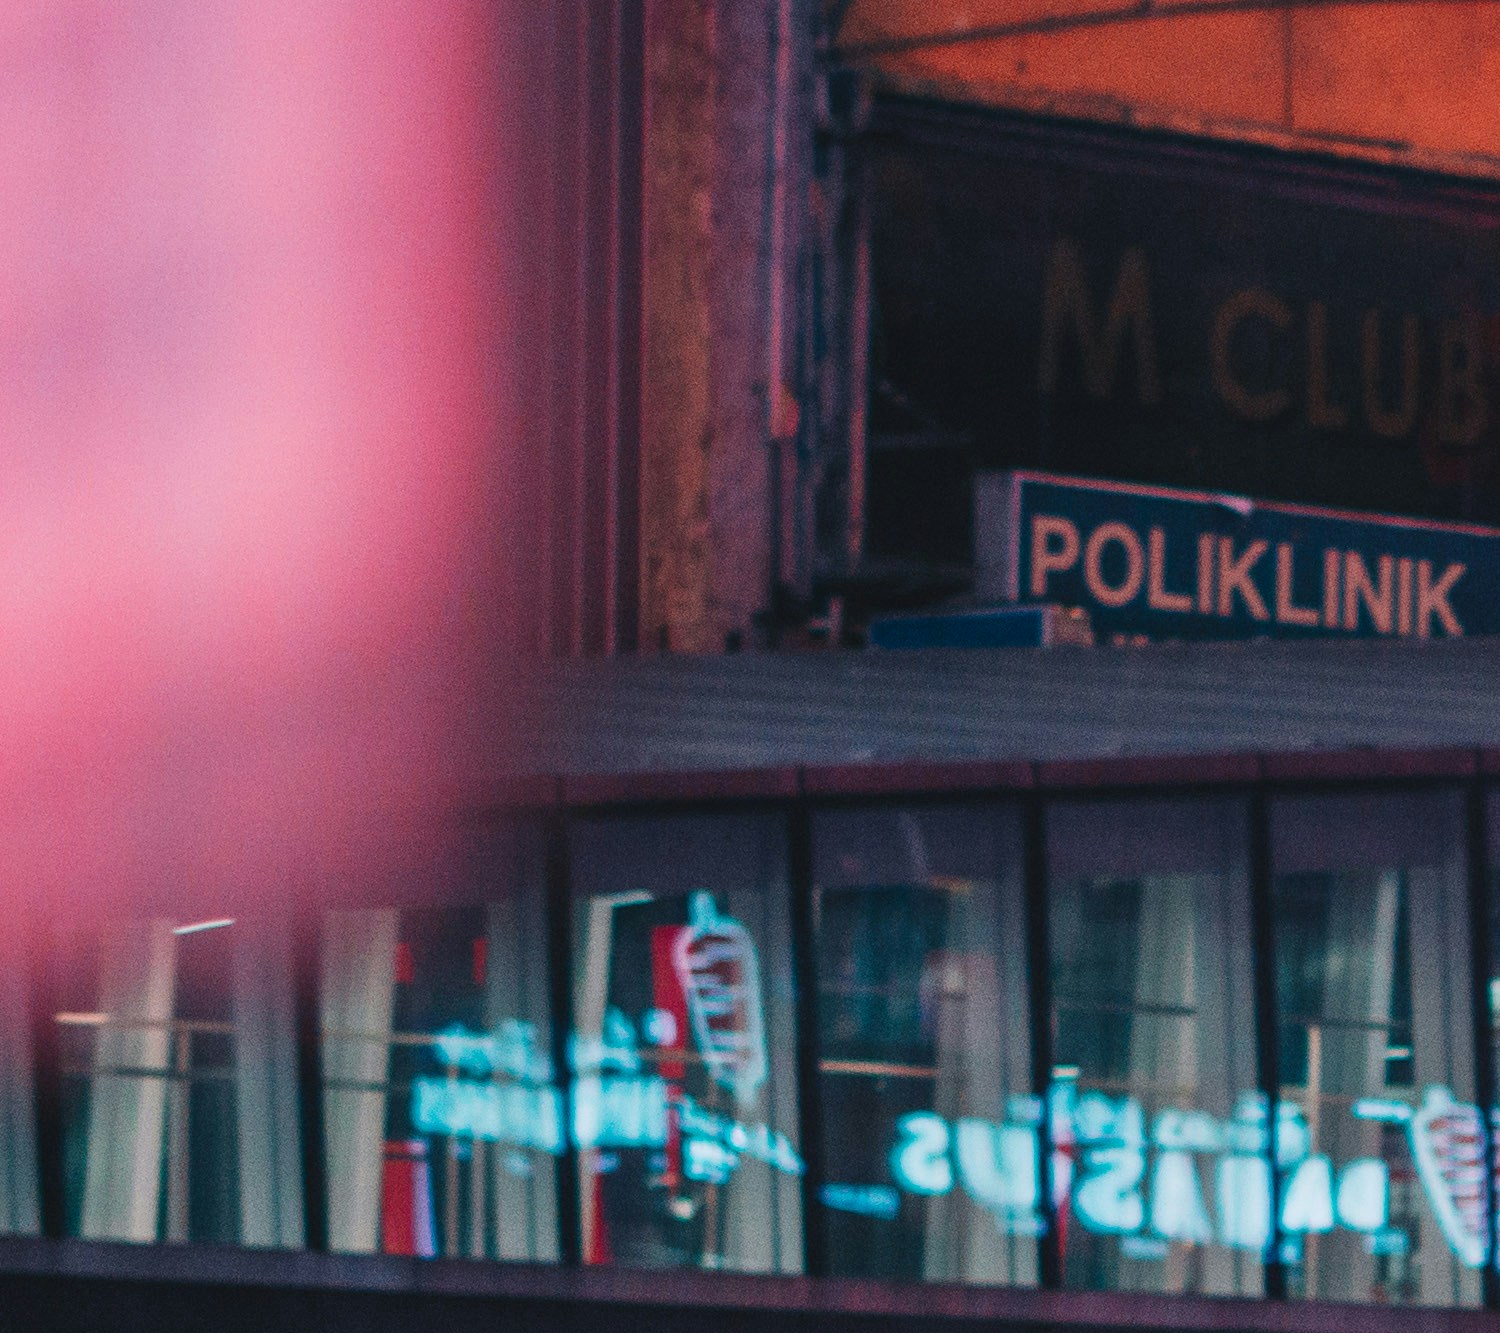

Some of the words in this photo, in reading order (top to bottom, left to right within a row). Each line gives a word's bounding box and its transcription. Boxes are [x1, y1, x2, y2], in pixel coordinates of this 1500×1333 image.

[1037, 237, 1160, 400] M
[1209, 288, 1487, 444] CLUB
[1030, 514, 1466, 638] POLIKLINIK
